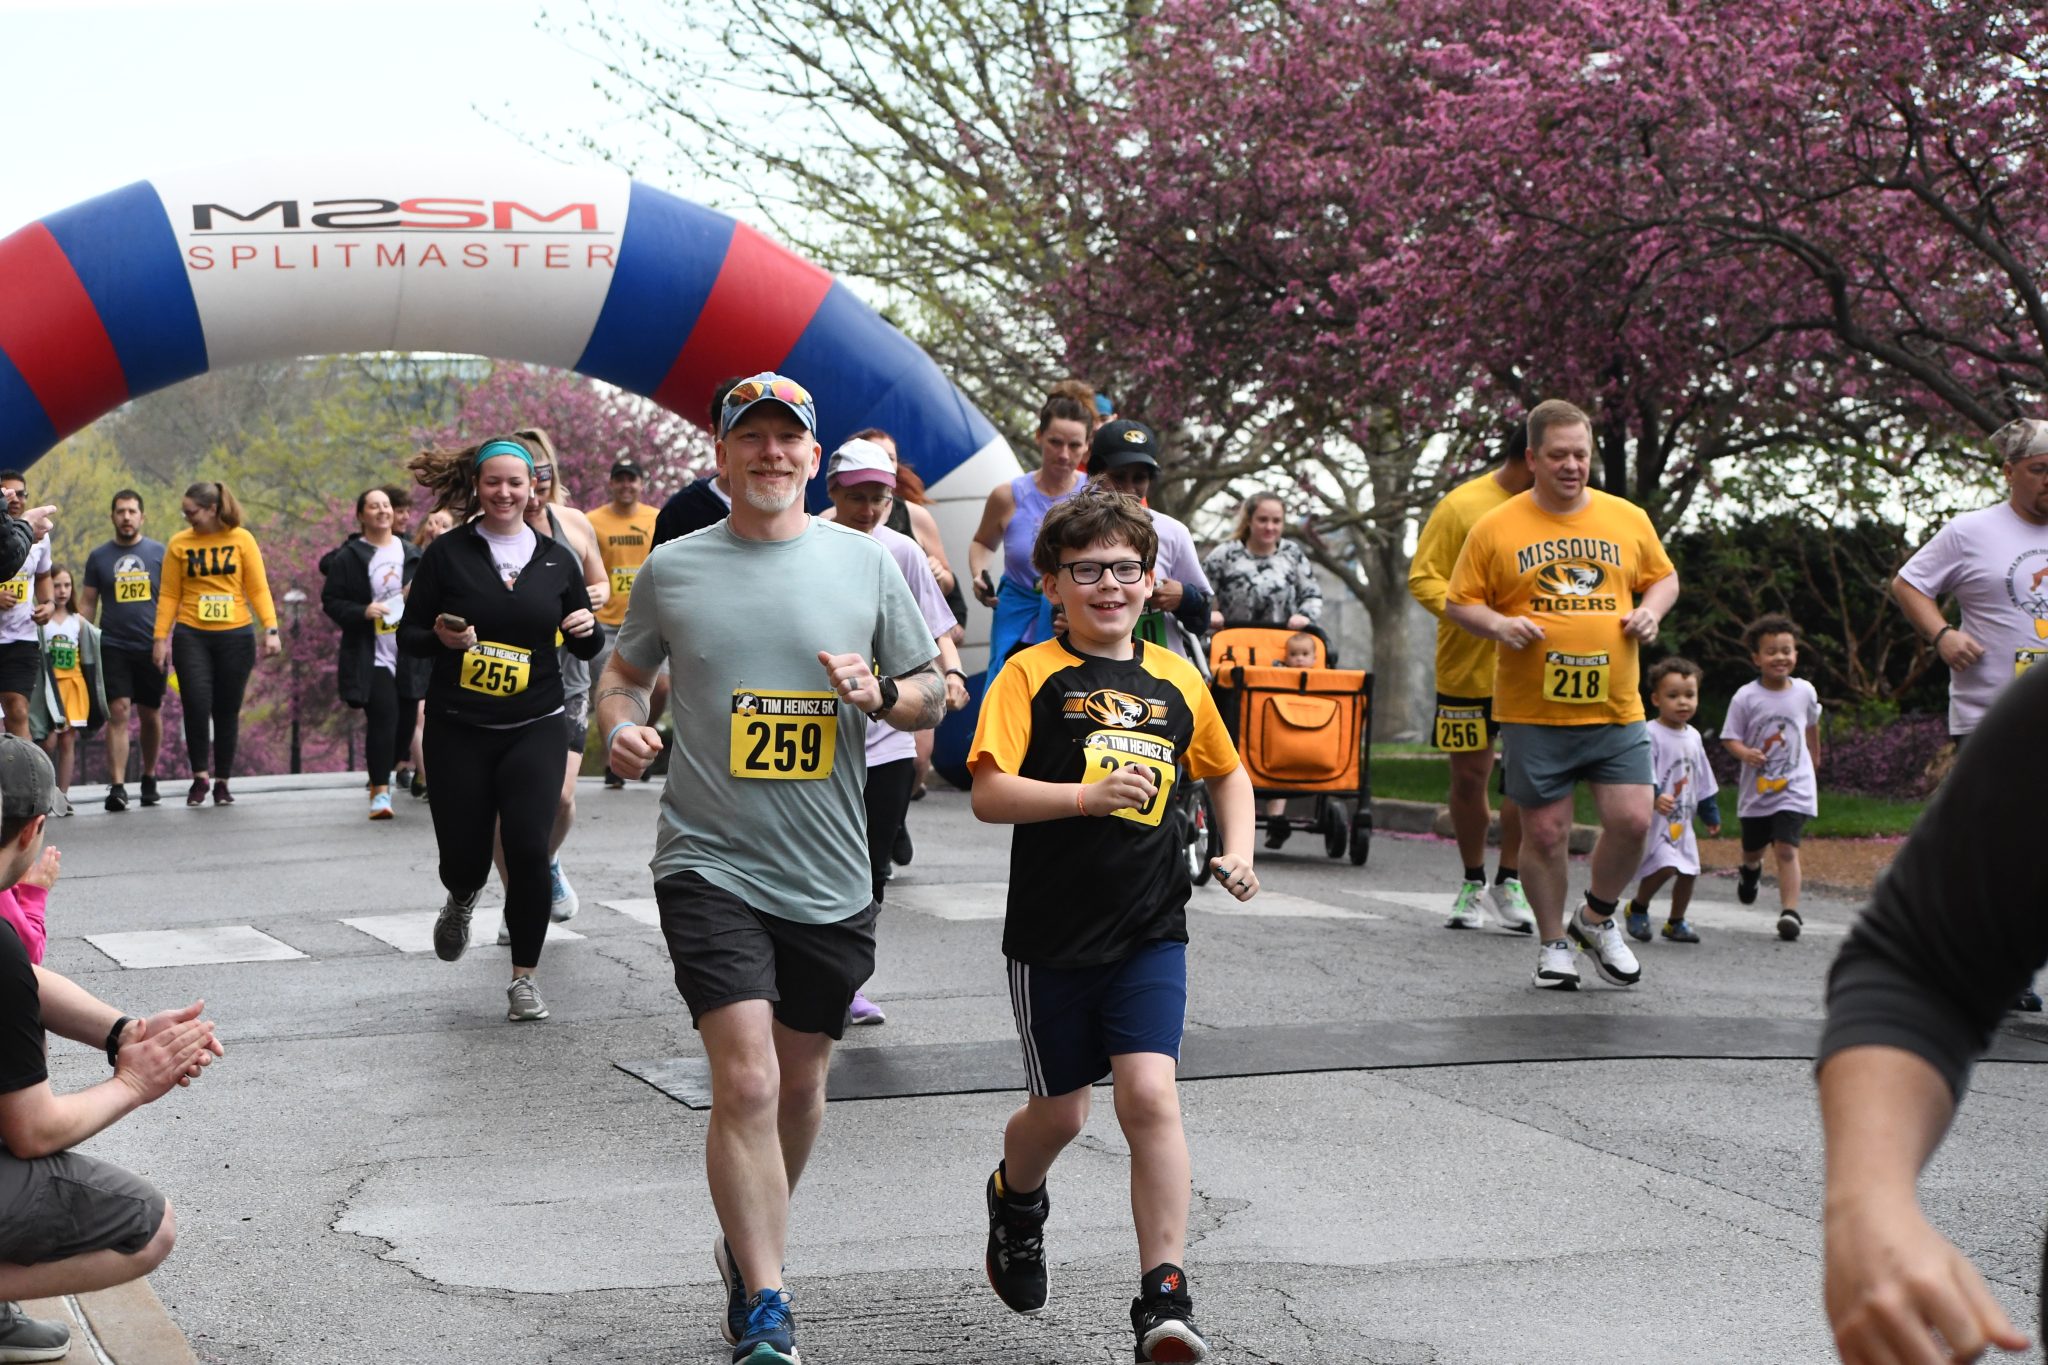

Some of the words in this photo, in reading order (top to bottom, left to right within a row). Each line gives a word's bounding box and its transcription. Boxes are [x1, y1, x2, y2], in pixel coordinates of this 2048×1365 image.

[188, 243, 616, 271] SPLITMASTER
[609, 535, 644, 546] PUMA
[186, 545, 237, 577] MIZ
[1517, 538, 1621, 574] MISSOURI
[121, 583, 146, 599] 262
[204, 603, 229, 618] 261
[1530, 597, 1617, 612] TIGERS
[482, 646, 496, 657] TIM
[470, 659, 519, 694] 255
[1553, 668, 1600, 698] 218
[761, 698, 782, 713] TIM
[783, 700, 820, 715] HEINSZ
[821, 701, 835, 715] 5K
[745, 721, 822, 772] 259
[1441, 722, 1478, 748] 256
[1109, 736, 1128, 752] TIM
[1130, 738, 1162, 759] HEINSZ
[1162, 748, 1173, 763] 5K
